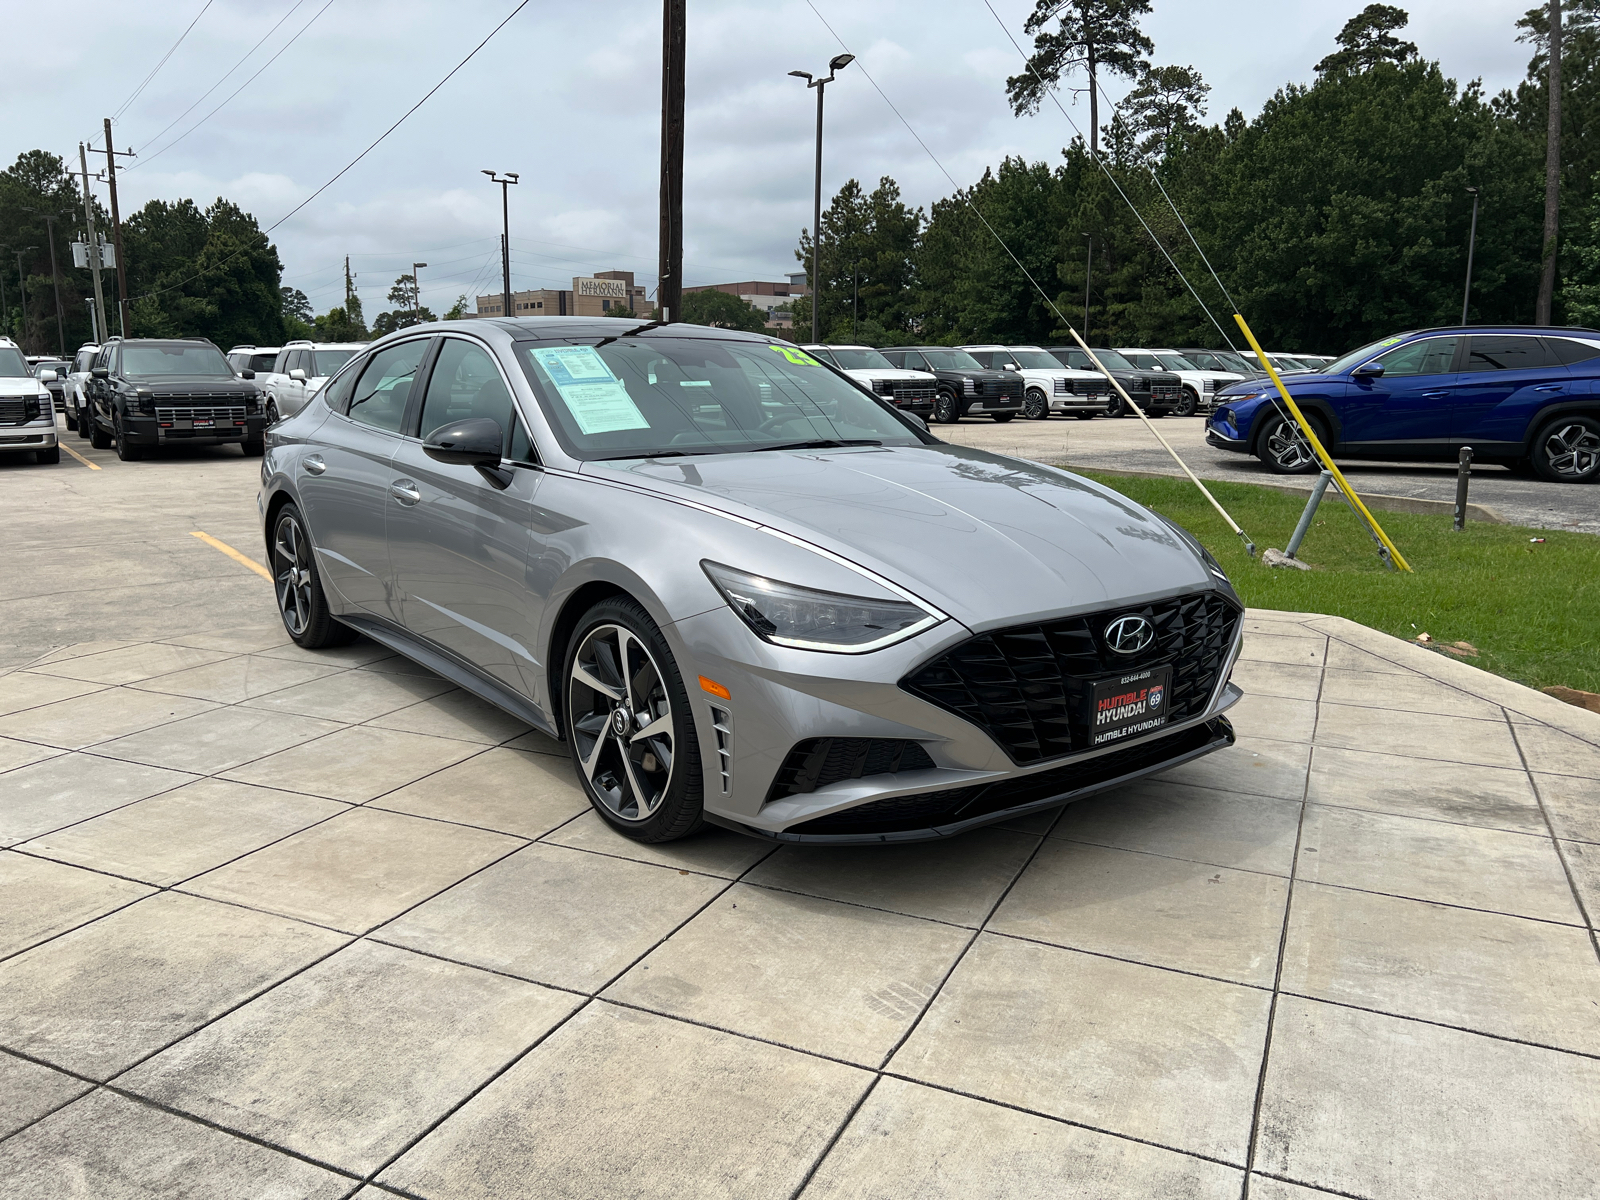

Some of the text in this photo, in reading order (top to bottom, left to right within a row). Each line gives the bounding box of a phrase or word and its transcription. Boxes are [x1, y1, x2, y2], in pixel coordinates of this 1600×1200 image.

[581, 281, 624, 291] MEMORIAL
[581, 286, 624, 296] HERMANN
[1150, 693, 1161, 706] 69
[1096, 700, 1146, 725] HYUNDAI
[1128, 718, 1161, 734] HYUNDAI
